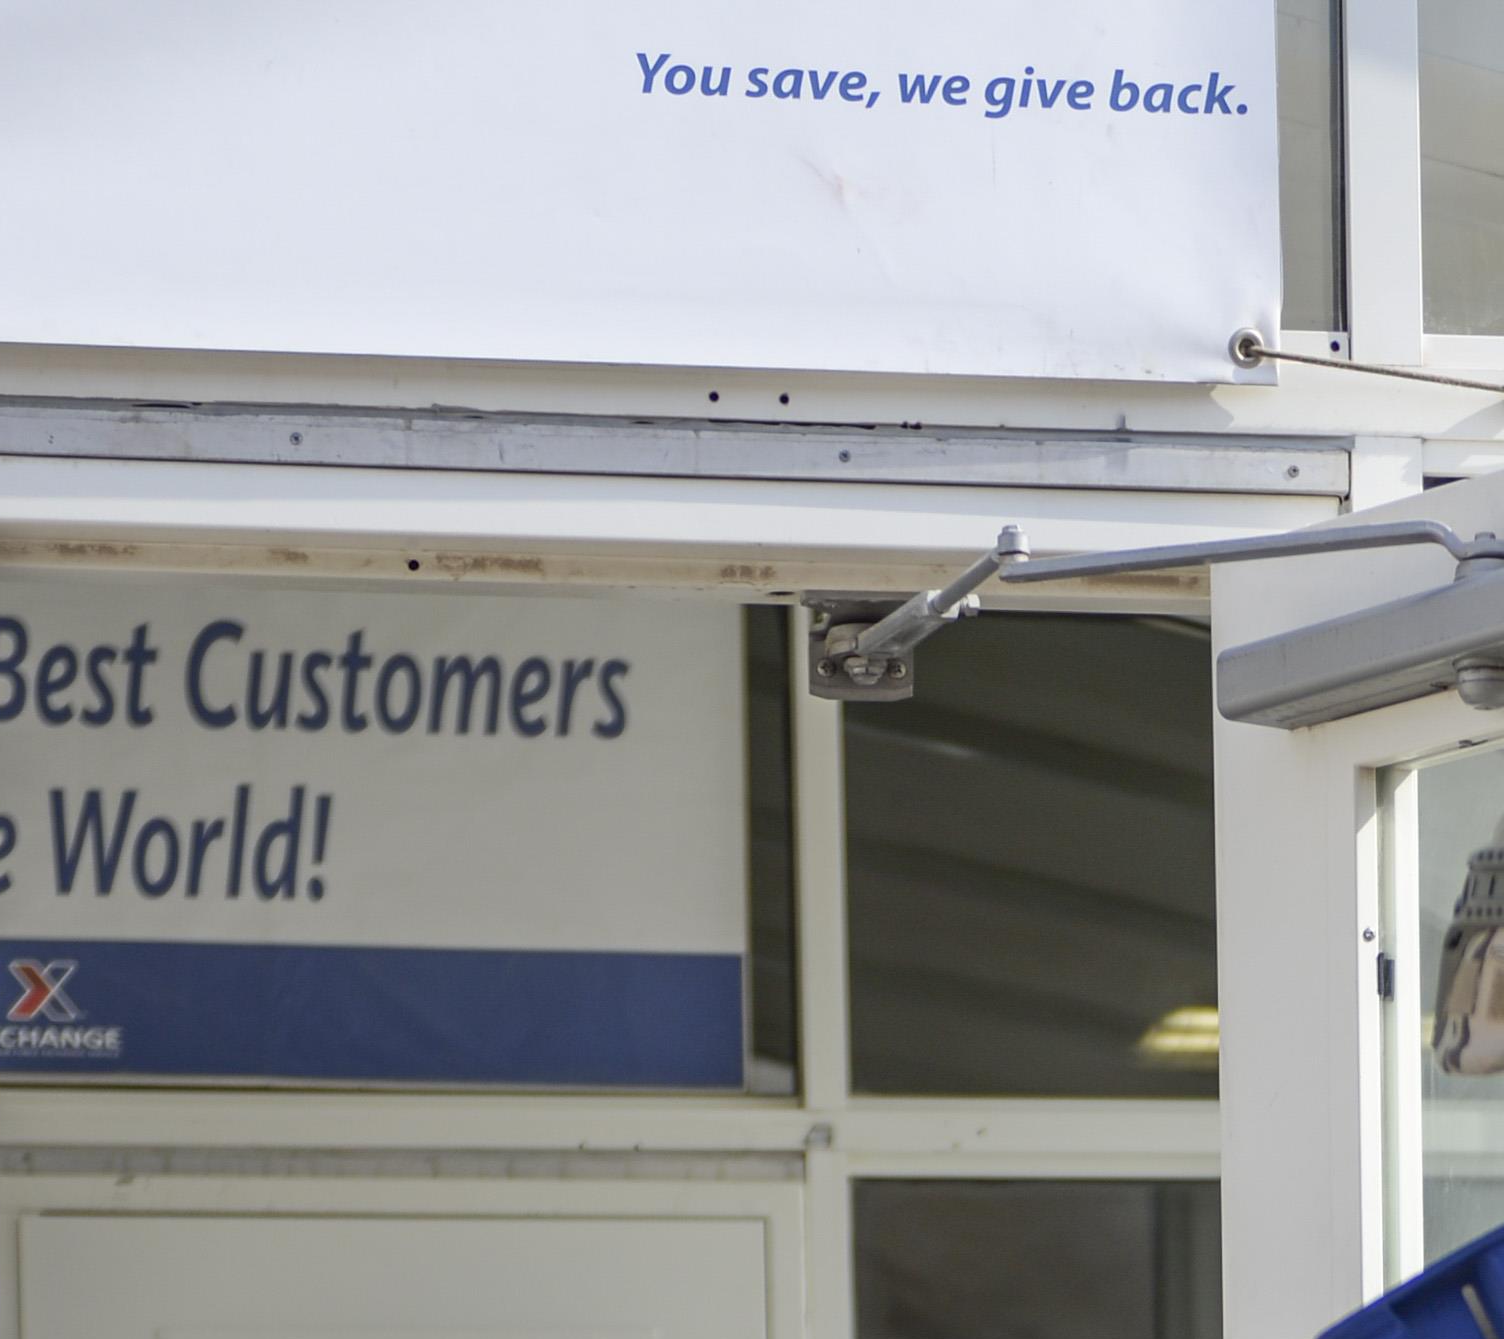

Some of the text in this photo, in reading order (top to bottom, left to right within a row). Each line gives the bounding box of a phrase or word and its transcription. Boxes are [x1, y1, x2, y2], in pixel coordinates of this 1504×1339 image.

[636, 52, 1251, 119] You save, we give back.
[184, 620, 632, 739] Customers
[49, 783, 335, 902] World!
